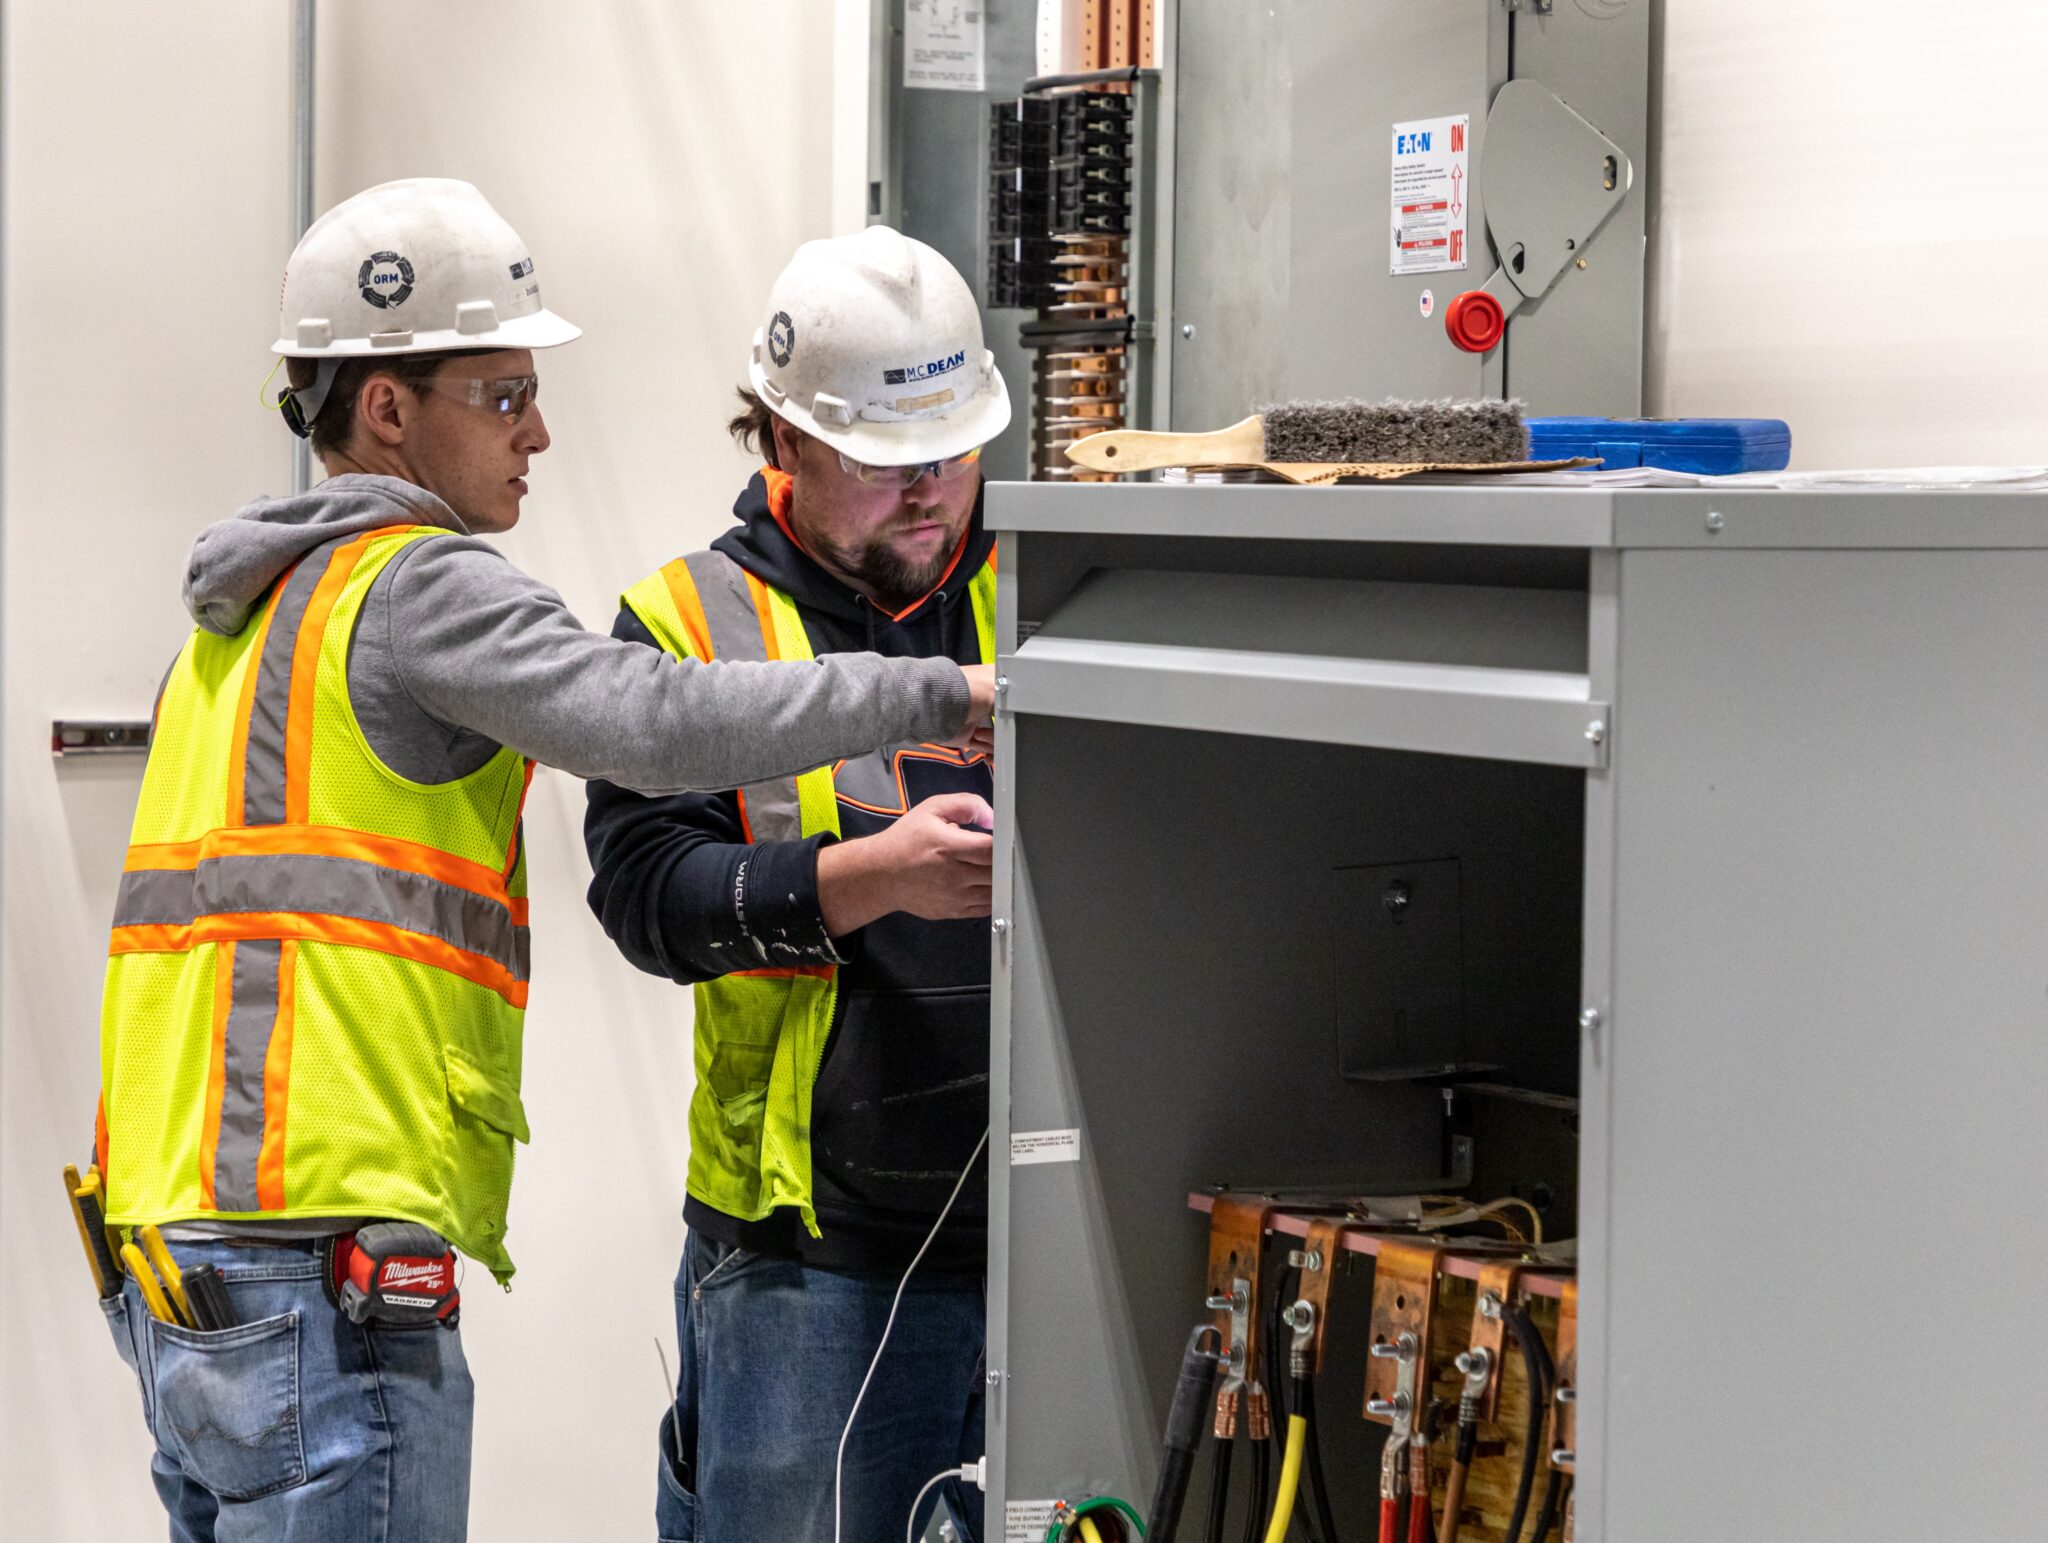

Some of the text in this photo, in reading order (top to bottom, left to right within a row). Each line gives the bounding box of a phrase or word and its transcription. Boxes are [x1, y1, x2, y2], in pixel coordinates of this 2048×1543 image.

[1397, 124, 1464, 155] EATON ON
[1450, 230, 1463, 262] OFF
[374, 273, 399, 284] ORM
[774, 331, 785, 348] ORM
[927, 351, 965, 374] DEAN
[735, 861, 747, 921] STORM
[384, 1261, 444, 1280] Milwaukee
[386, 1297, 432, 1306] MAGNETIC
